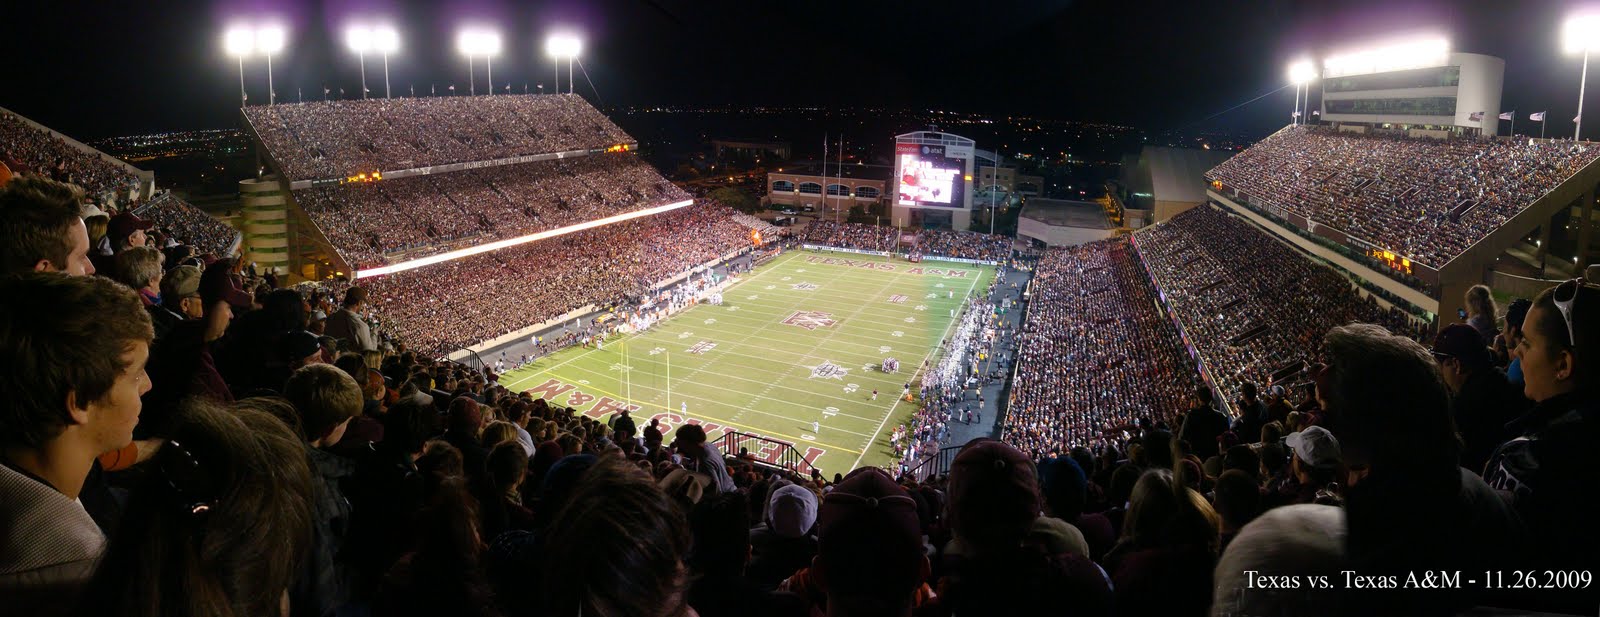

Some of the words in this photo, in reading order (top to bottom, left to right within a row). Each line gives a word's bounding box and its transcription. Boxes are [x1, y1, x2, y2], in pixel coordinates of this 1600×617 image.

[463, 161, 482, 169] HOME
[805, 255, 897, 271] TEXAS
[906, 266, 968, 277] A&M
